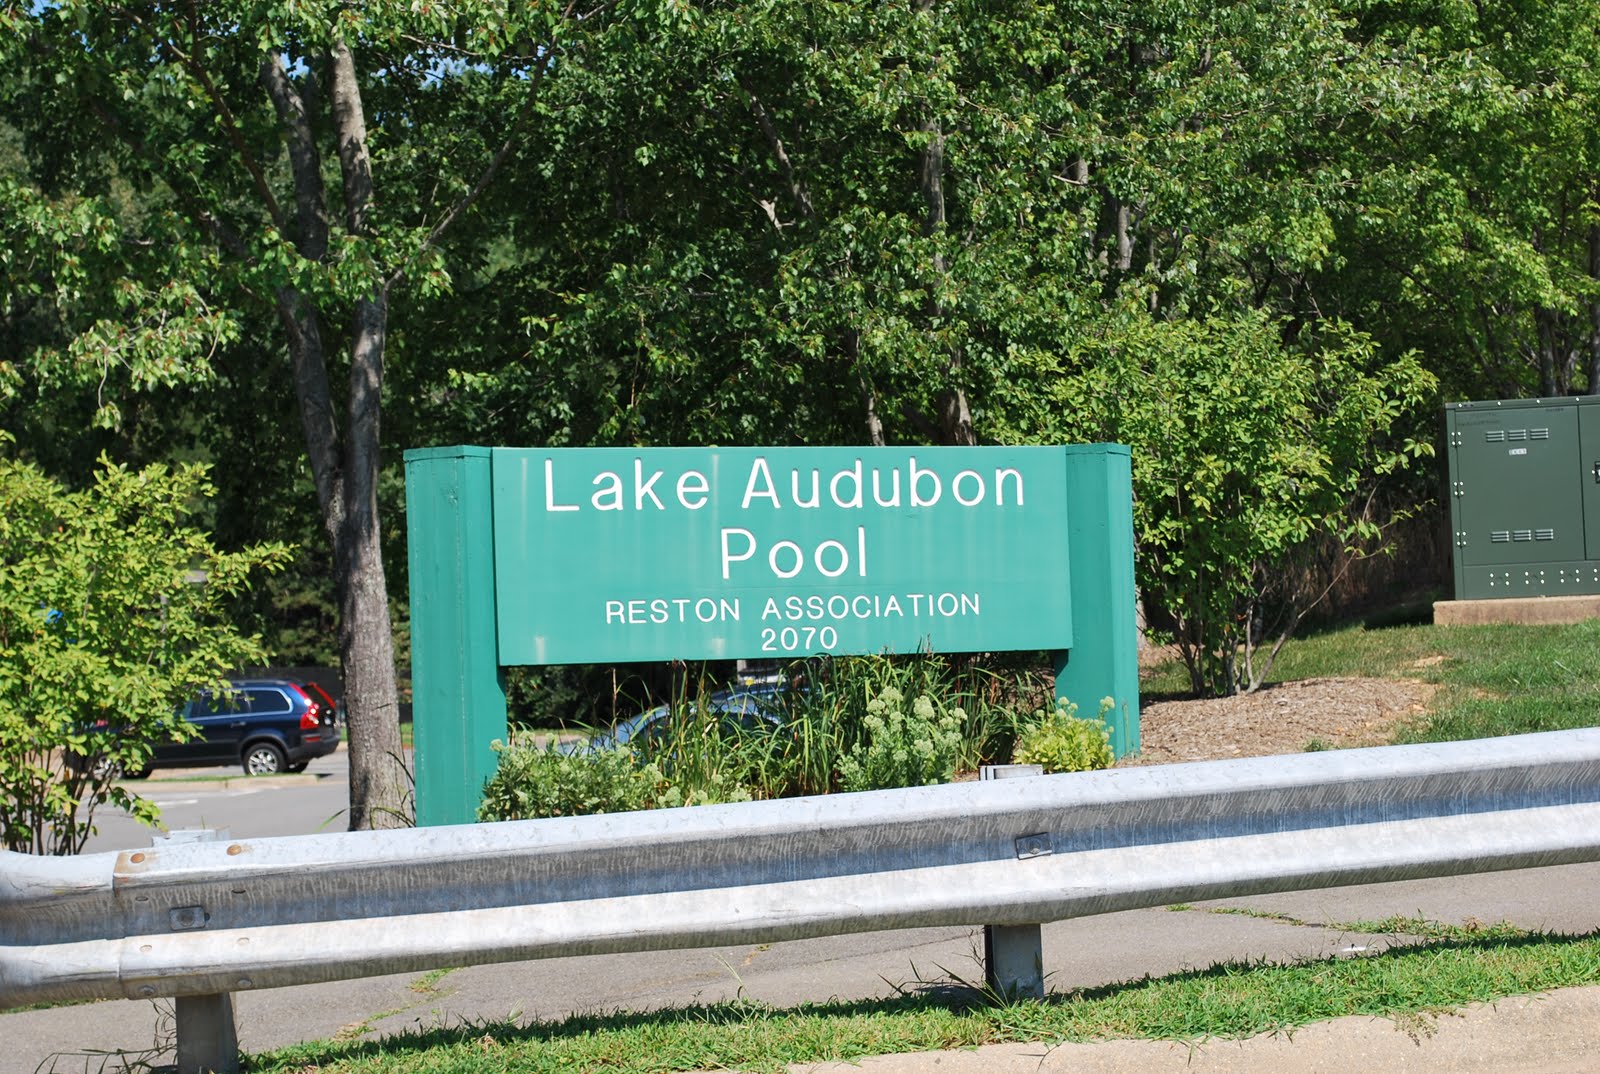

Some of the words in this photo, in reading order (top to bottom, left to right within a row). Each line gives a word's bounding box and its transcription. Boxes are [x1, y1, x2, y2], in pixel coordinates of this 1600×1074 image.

[544, 459, 710, 512] Lake
[741, 457, 1024, 509] Audubon
[720, 526, 867, 580] Pool
[605, 597, 740, 625] RESTON
[761, 593, 980, 621] ASSOCIATION
[761, 625, 838, 652] 2070
